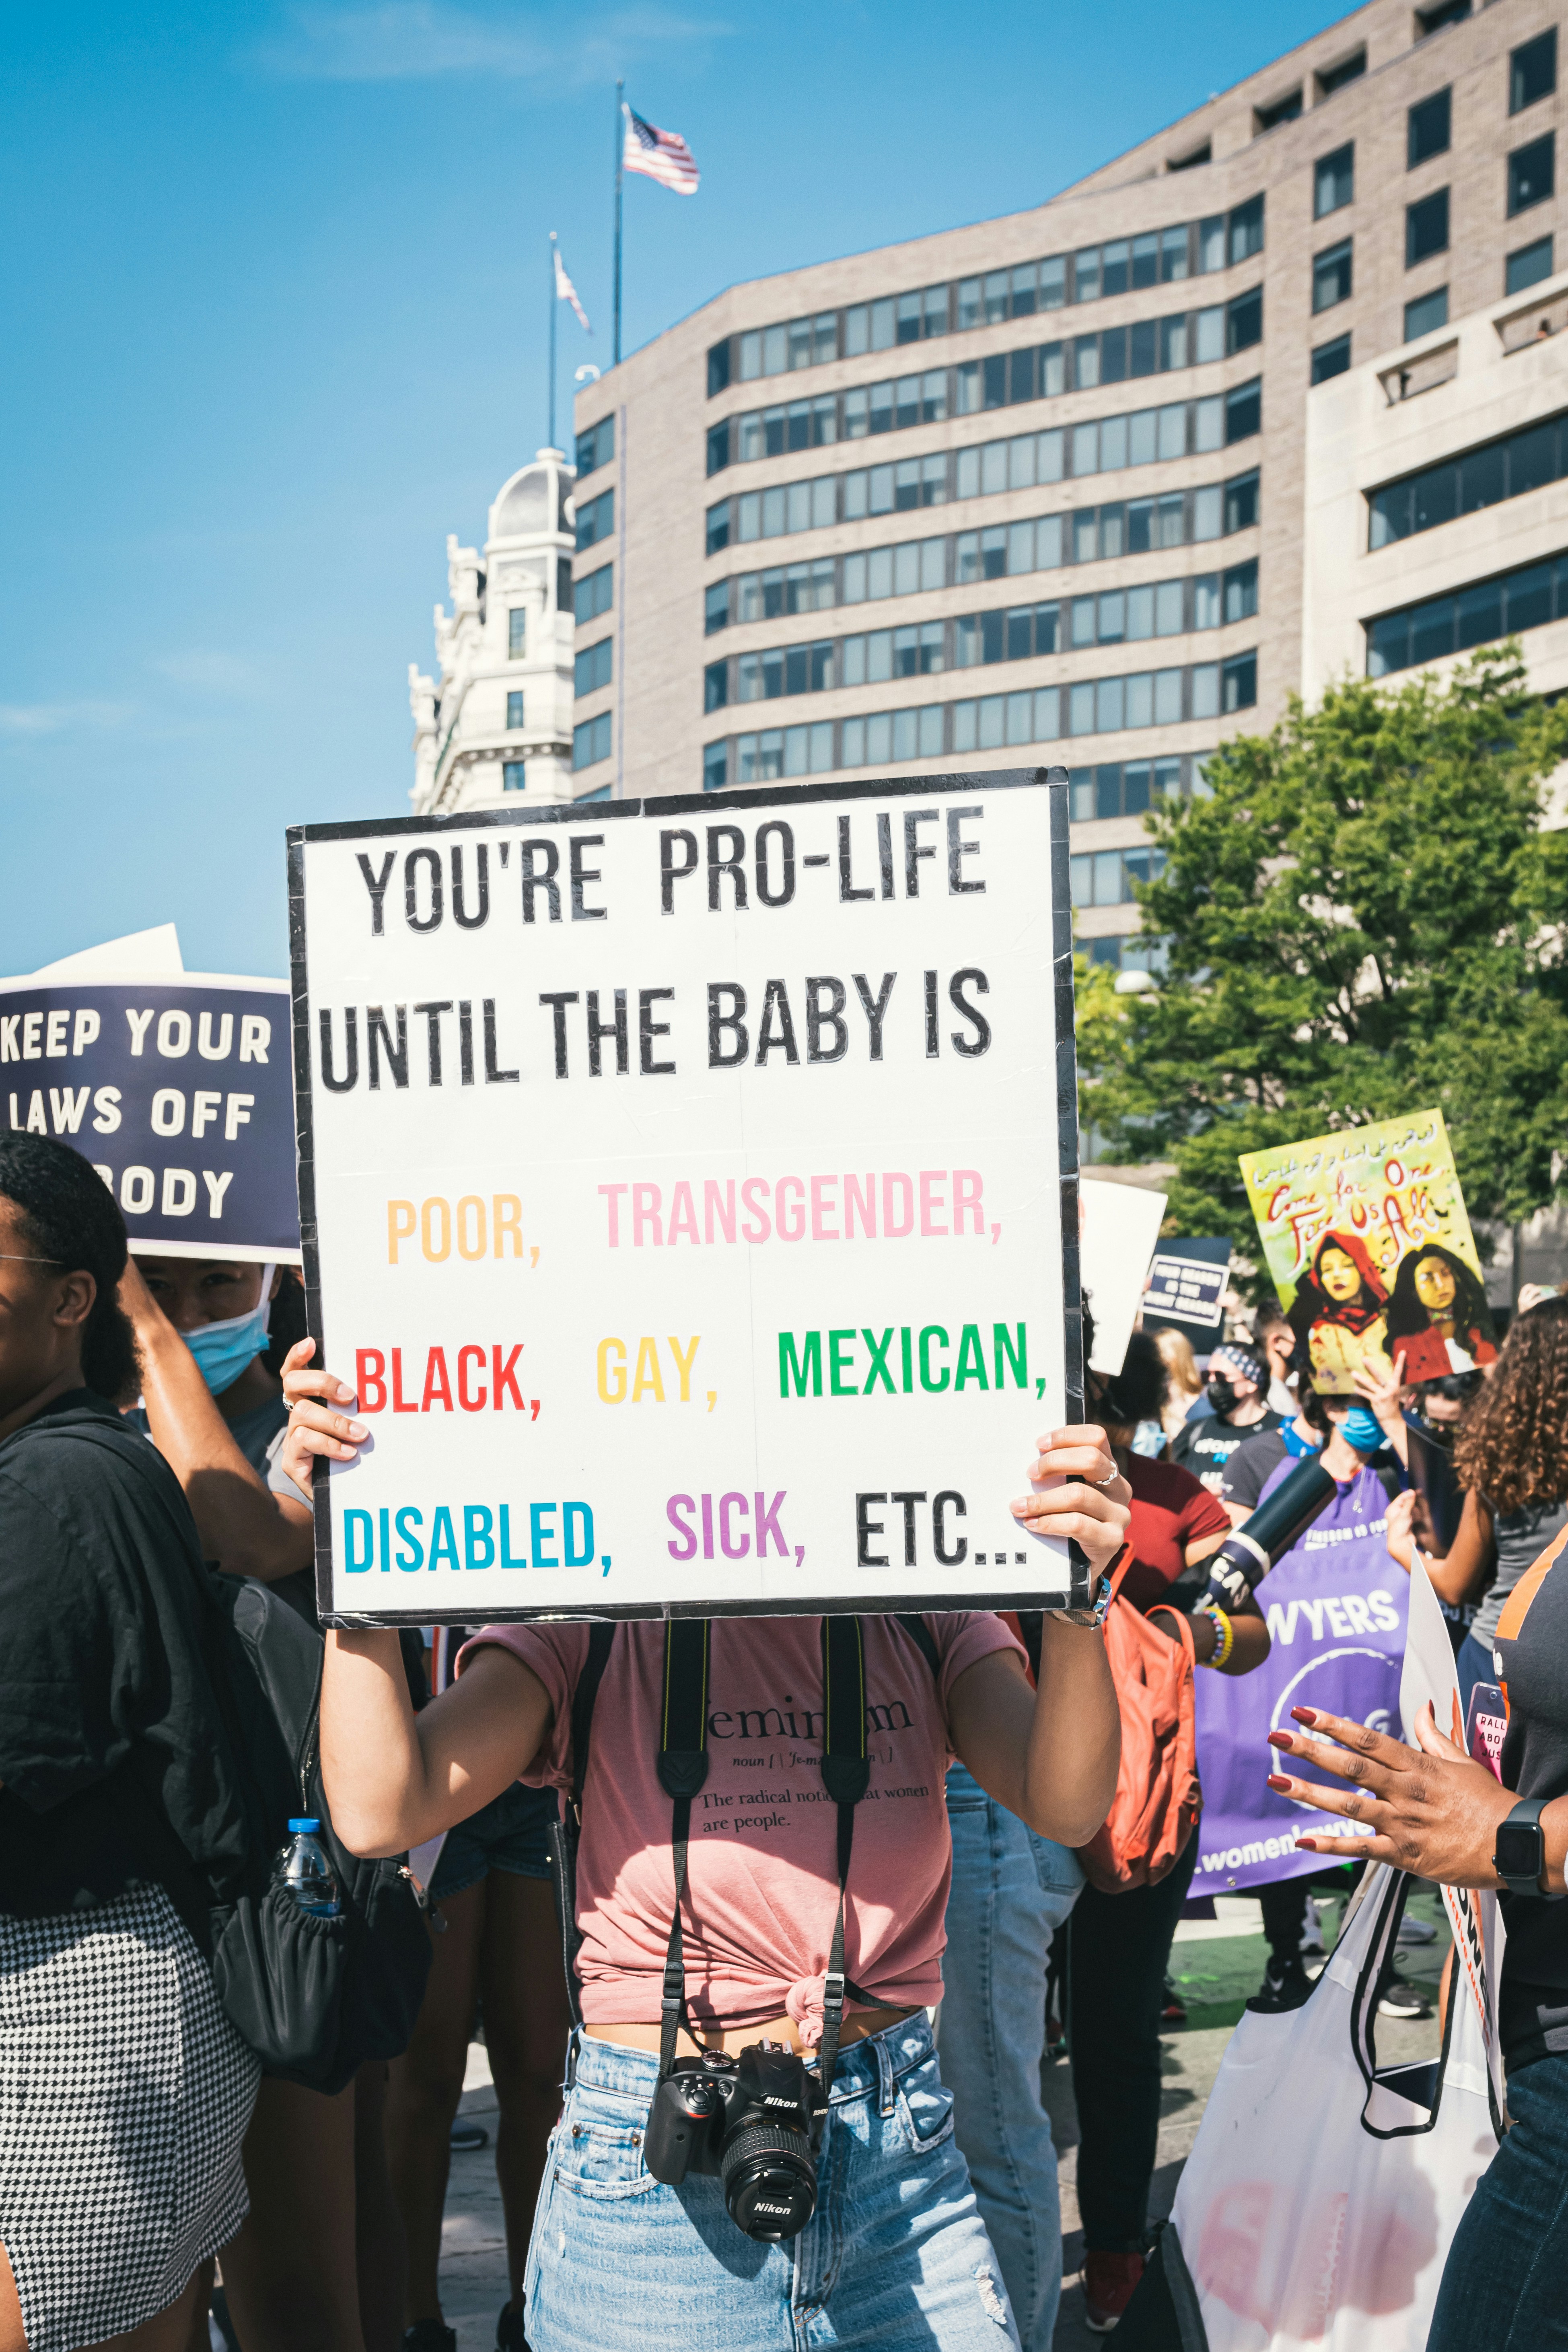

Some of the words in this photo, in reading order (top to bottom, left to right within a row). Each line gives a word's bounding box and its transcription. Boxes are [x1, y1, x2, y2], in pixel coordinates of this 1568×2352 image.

[354, 833, 607, 936] YOU'RE
[660, 805, 986, 916] PRO-LIFE
[1, 1009, 101, 1063] KEEP
[125, 1008, 271, 1064] YOUR
[318, 998, 520, 1094] UNTIL
[538, 987, 676, 1079] THE
[707, 971, 897, 1069] BABY
[924, 967, 992, 1059] IS
[9, 1086, 122, 1135] LAWS
[151, 1088, 255, 1140] OFF
[1330, 1169, 1369, 1208] for
[387, 1193, 540, 1267] POOR,
[597, 1169, 1002, 1247] TRANSGENDER,
[1350, 1203, 1379, 1229] Us
[1379, 1187, 1435, 1266] All
[355, 1344, 541, 1421] BLACK,
[597, 1335, 717, 1413] GAY,
[778, 1322, 1046, 1400] MEXICAN,
[344, 1501, 612, 1577] DISABLED,
[666, 1491, 805, 1568] SICK,
[855, 1490, 1027, 1568] ETC...
[707, 1695, 915, 1739] eminm
[733, 1757, 764, 1766] noun
[699, 1792, 733, 1809] The
[739, 1788, 791, 1805] radical
[796, 1788, 834, 1802] notio
[703, 1819, 729, 1833] are
[734, 1812, 791, 1833] people.
[764, 2096, 798, 2108] Nikon
[754, 2202, 791, 2215] Nikon
